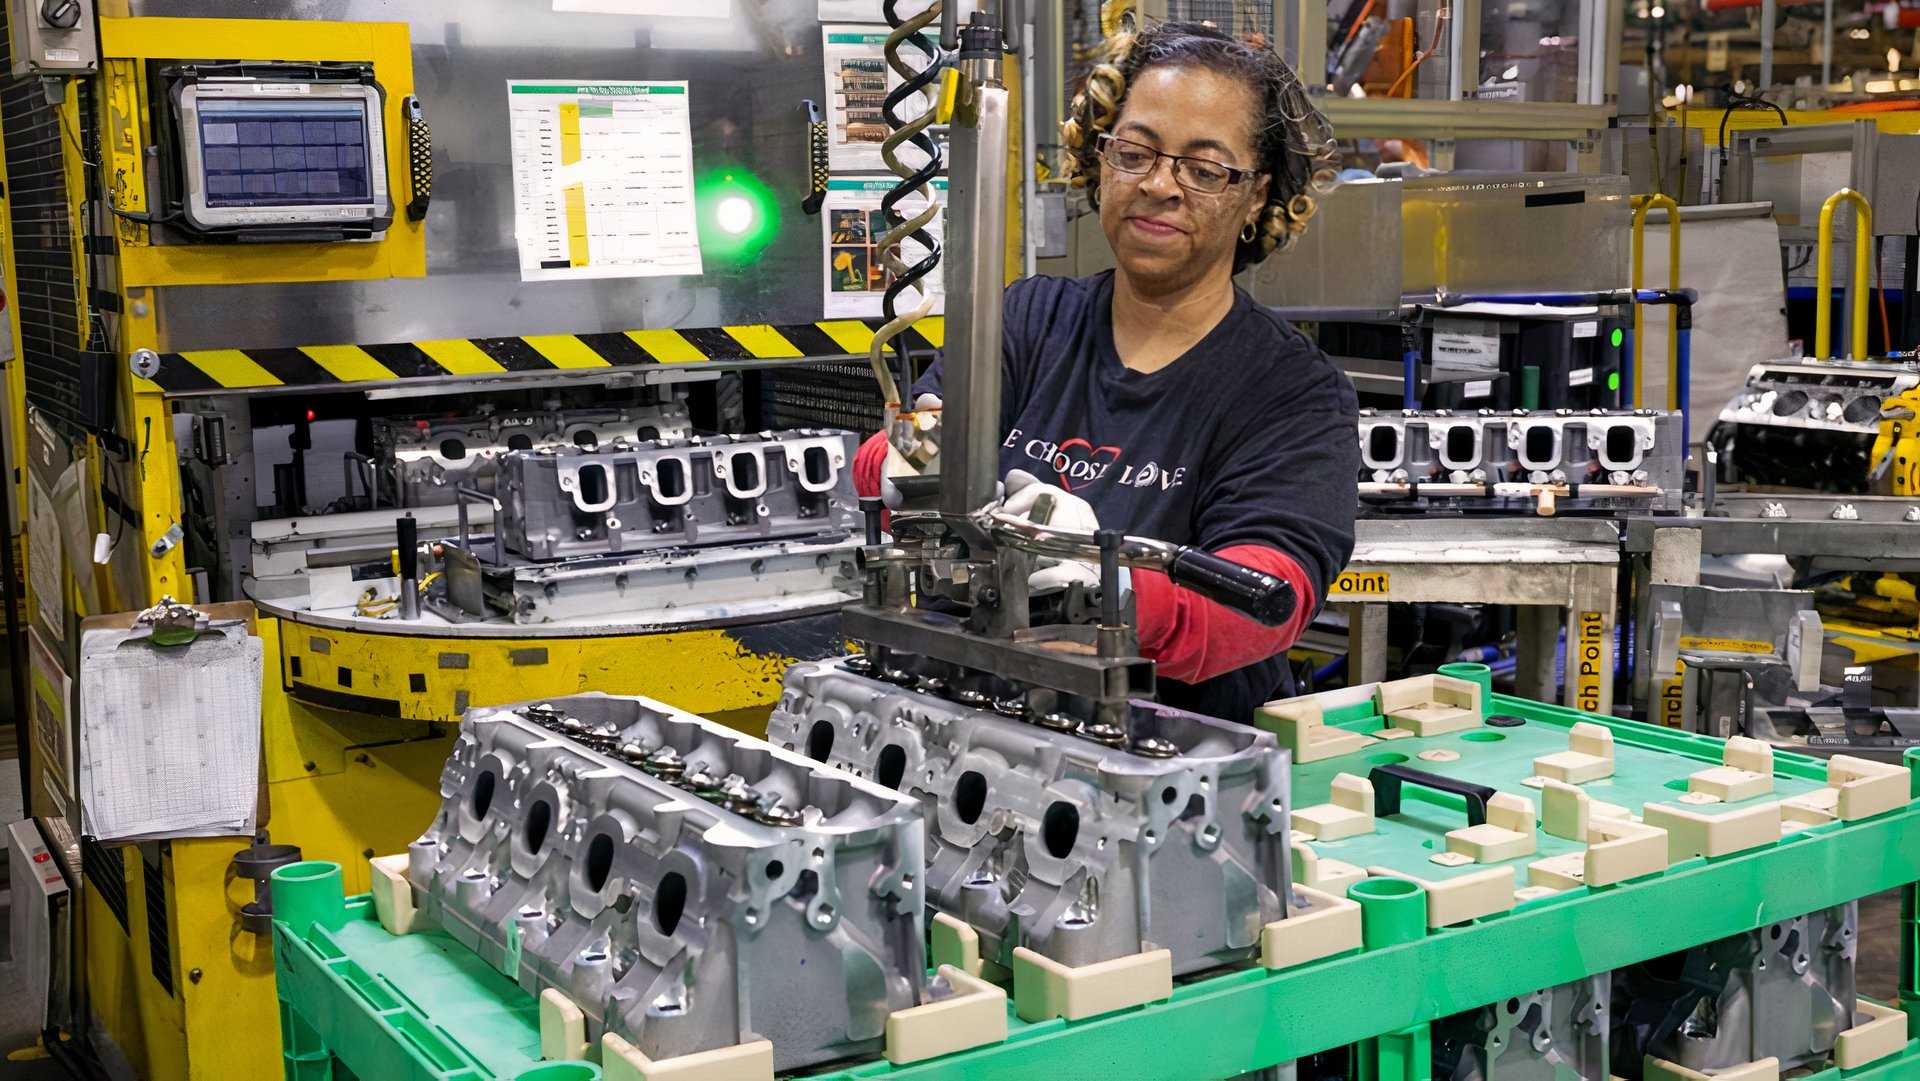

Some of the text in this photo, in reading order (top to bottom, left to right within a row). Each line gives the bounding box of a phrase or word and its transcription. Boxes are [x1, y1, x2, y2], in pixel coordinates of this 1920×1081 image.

[1002, 428, 1023, 448] E
[1118, 460, 1187, 491] LOVE
[1339, 572, 1385, 592] oint
[1580, 611, 1602, 676] Point
